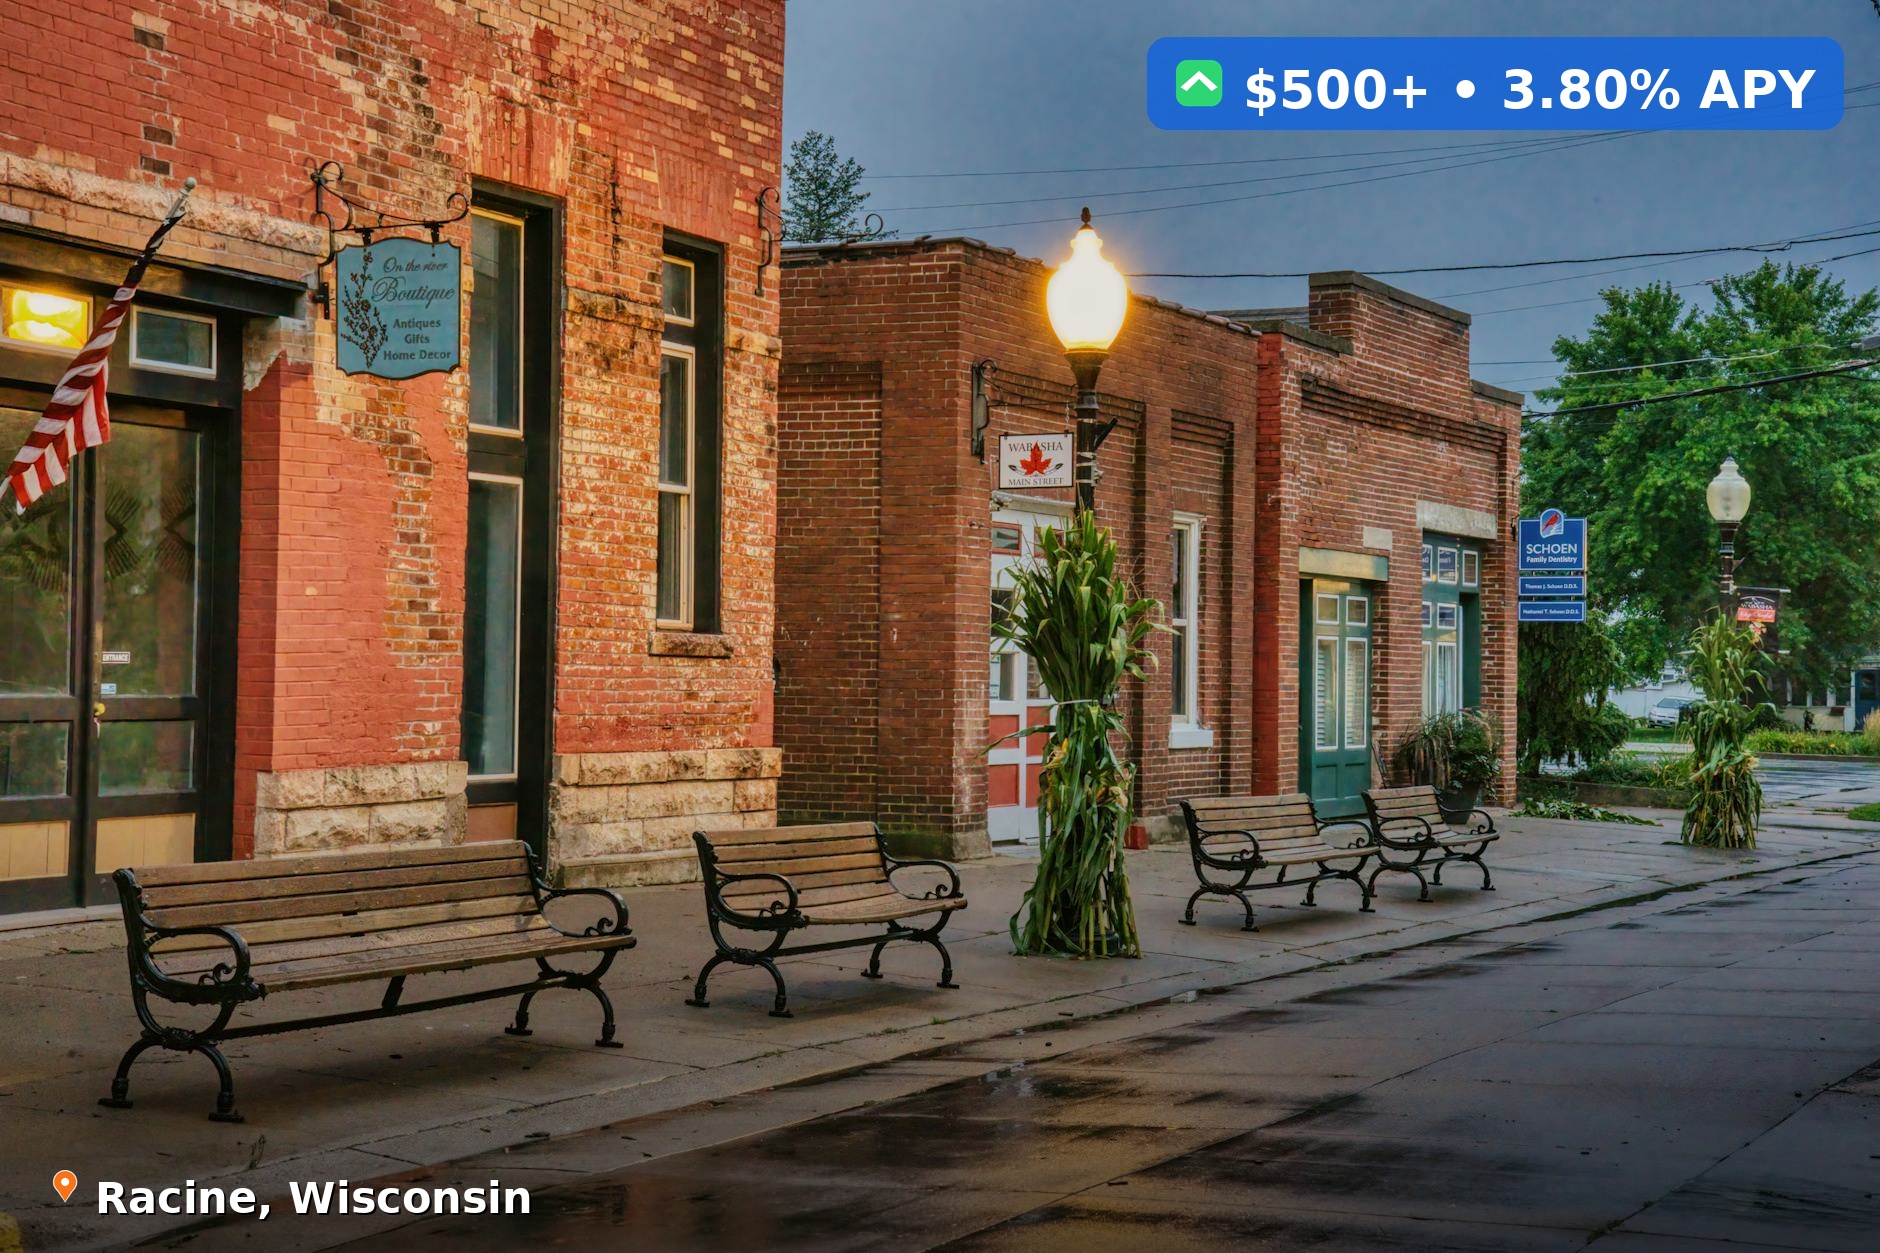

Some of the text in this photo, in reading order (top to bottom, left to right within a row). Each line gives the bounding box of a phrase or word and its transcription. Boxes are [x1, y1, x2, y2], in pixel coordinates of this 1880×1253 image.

[383, 256, 402, 273] On
[405, 259, 421, 272] the
[371, 276, 455, 309] Boutique
[393, 318, 441, 330] Antiques
[404, 333, 430, 344] Gifts
[384, 350, 451, 360] Home Decor
[1008, 441, 1064, 452] WABASHA
[1032, 478, 1064, 486] STREET
[1526, 543, 1578, 554] SCHOEN
[1548, 556, 1577, 564] Dentistry
